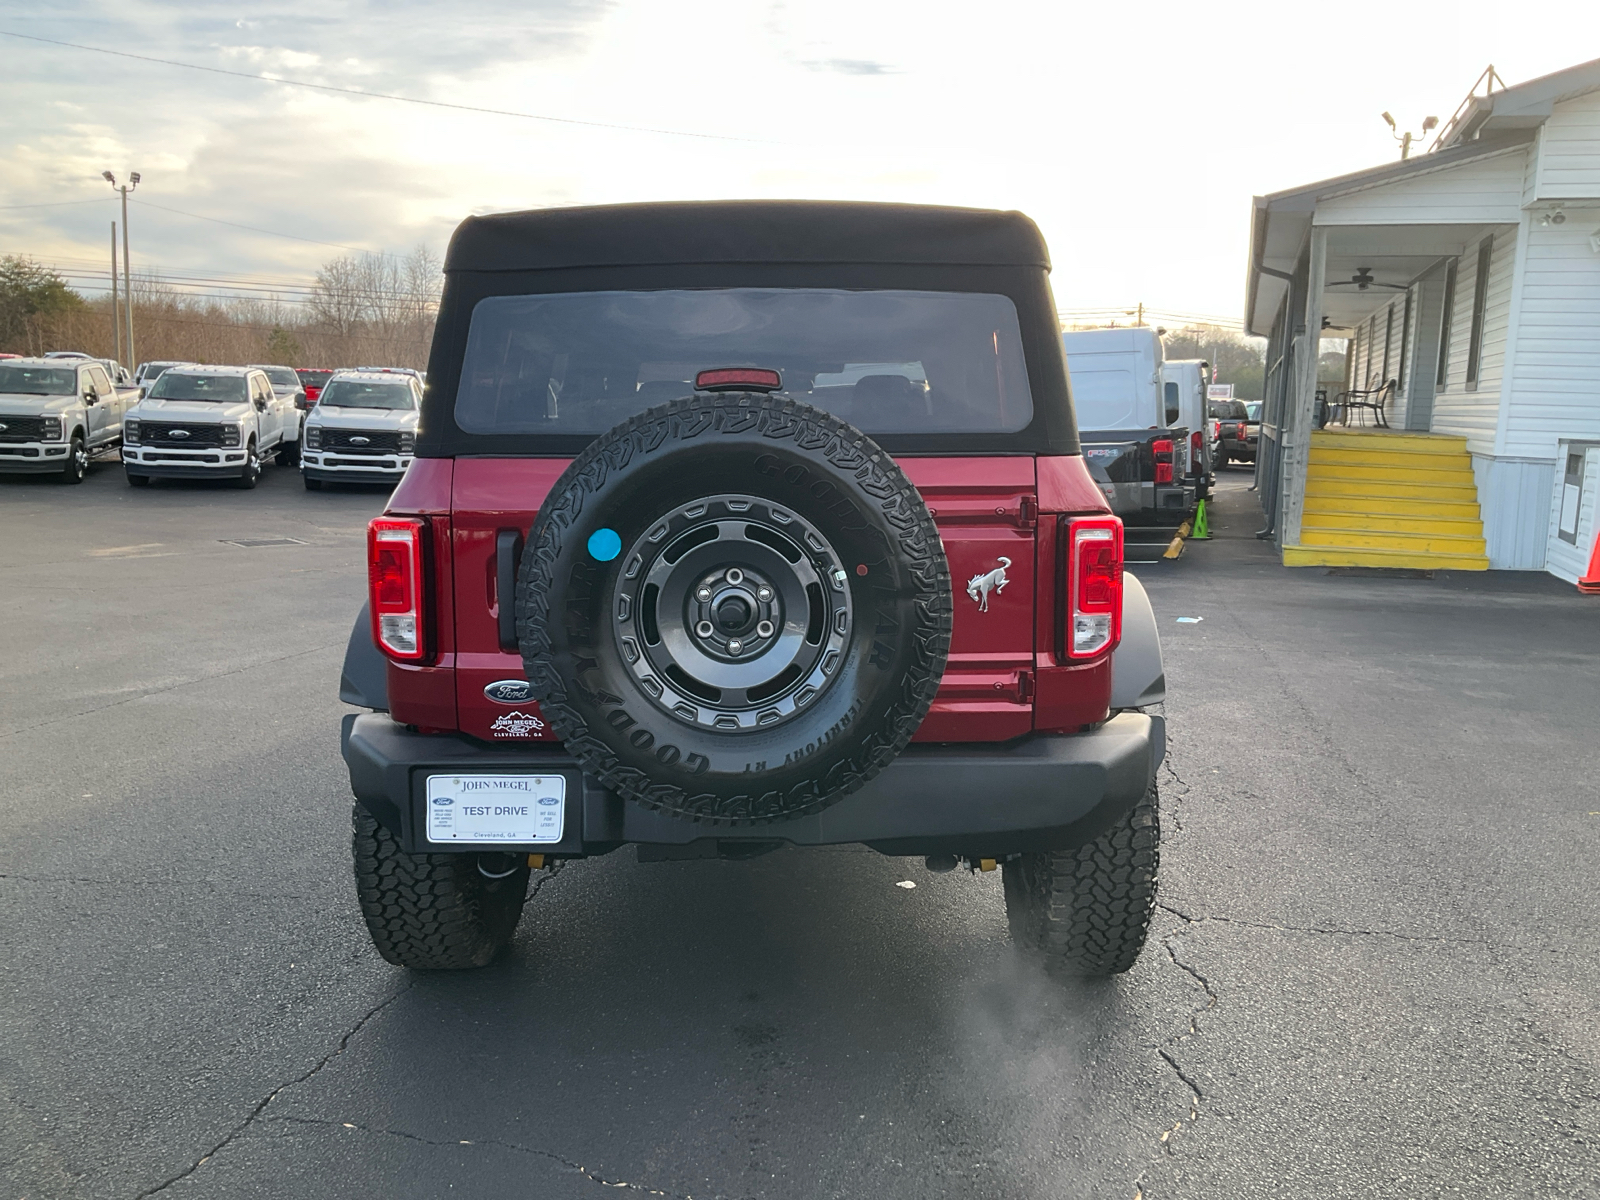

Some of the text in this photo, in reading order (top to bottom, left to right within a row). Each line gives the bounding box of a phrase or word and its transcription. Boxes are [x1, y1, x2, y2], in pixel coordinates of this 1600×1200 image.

[497, 685, 528, 698] Ford
[461, 780, 532, 792] JOHN MEGEL
[463, 806, 529, 816] TEST DRIVE
